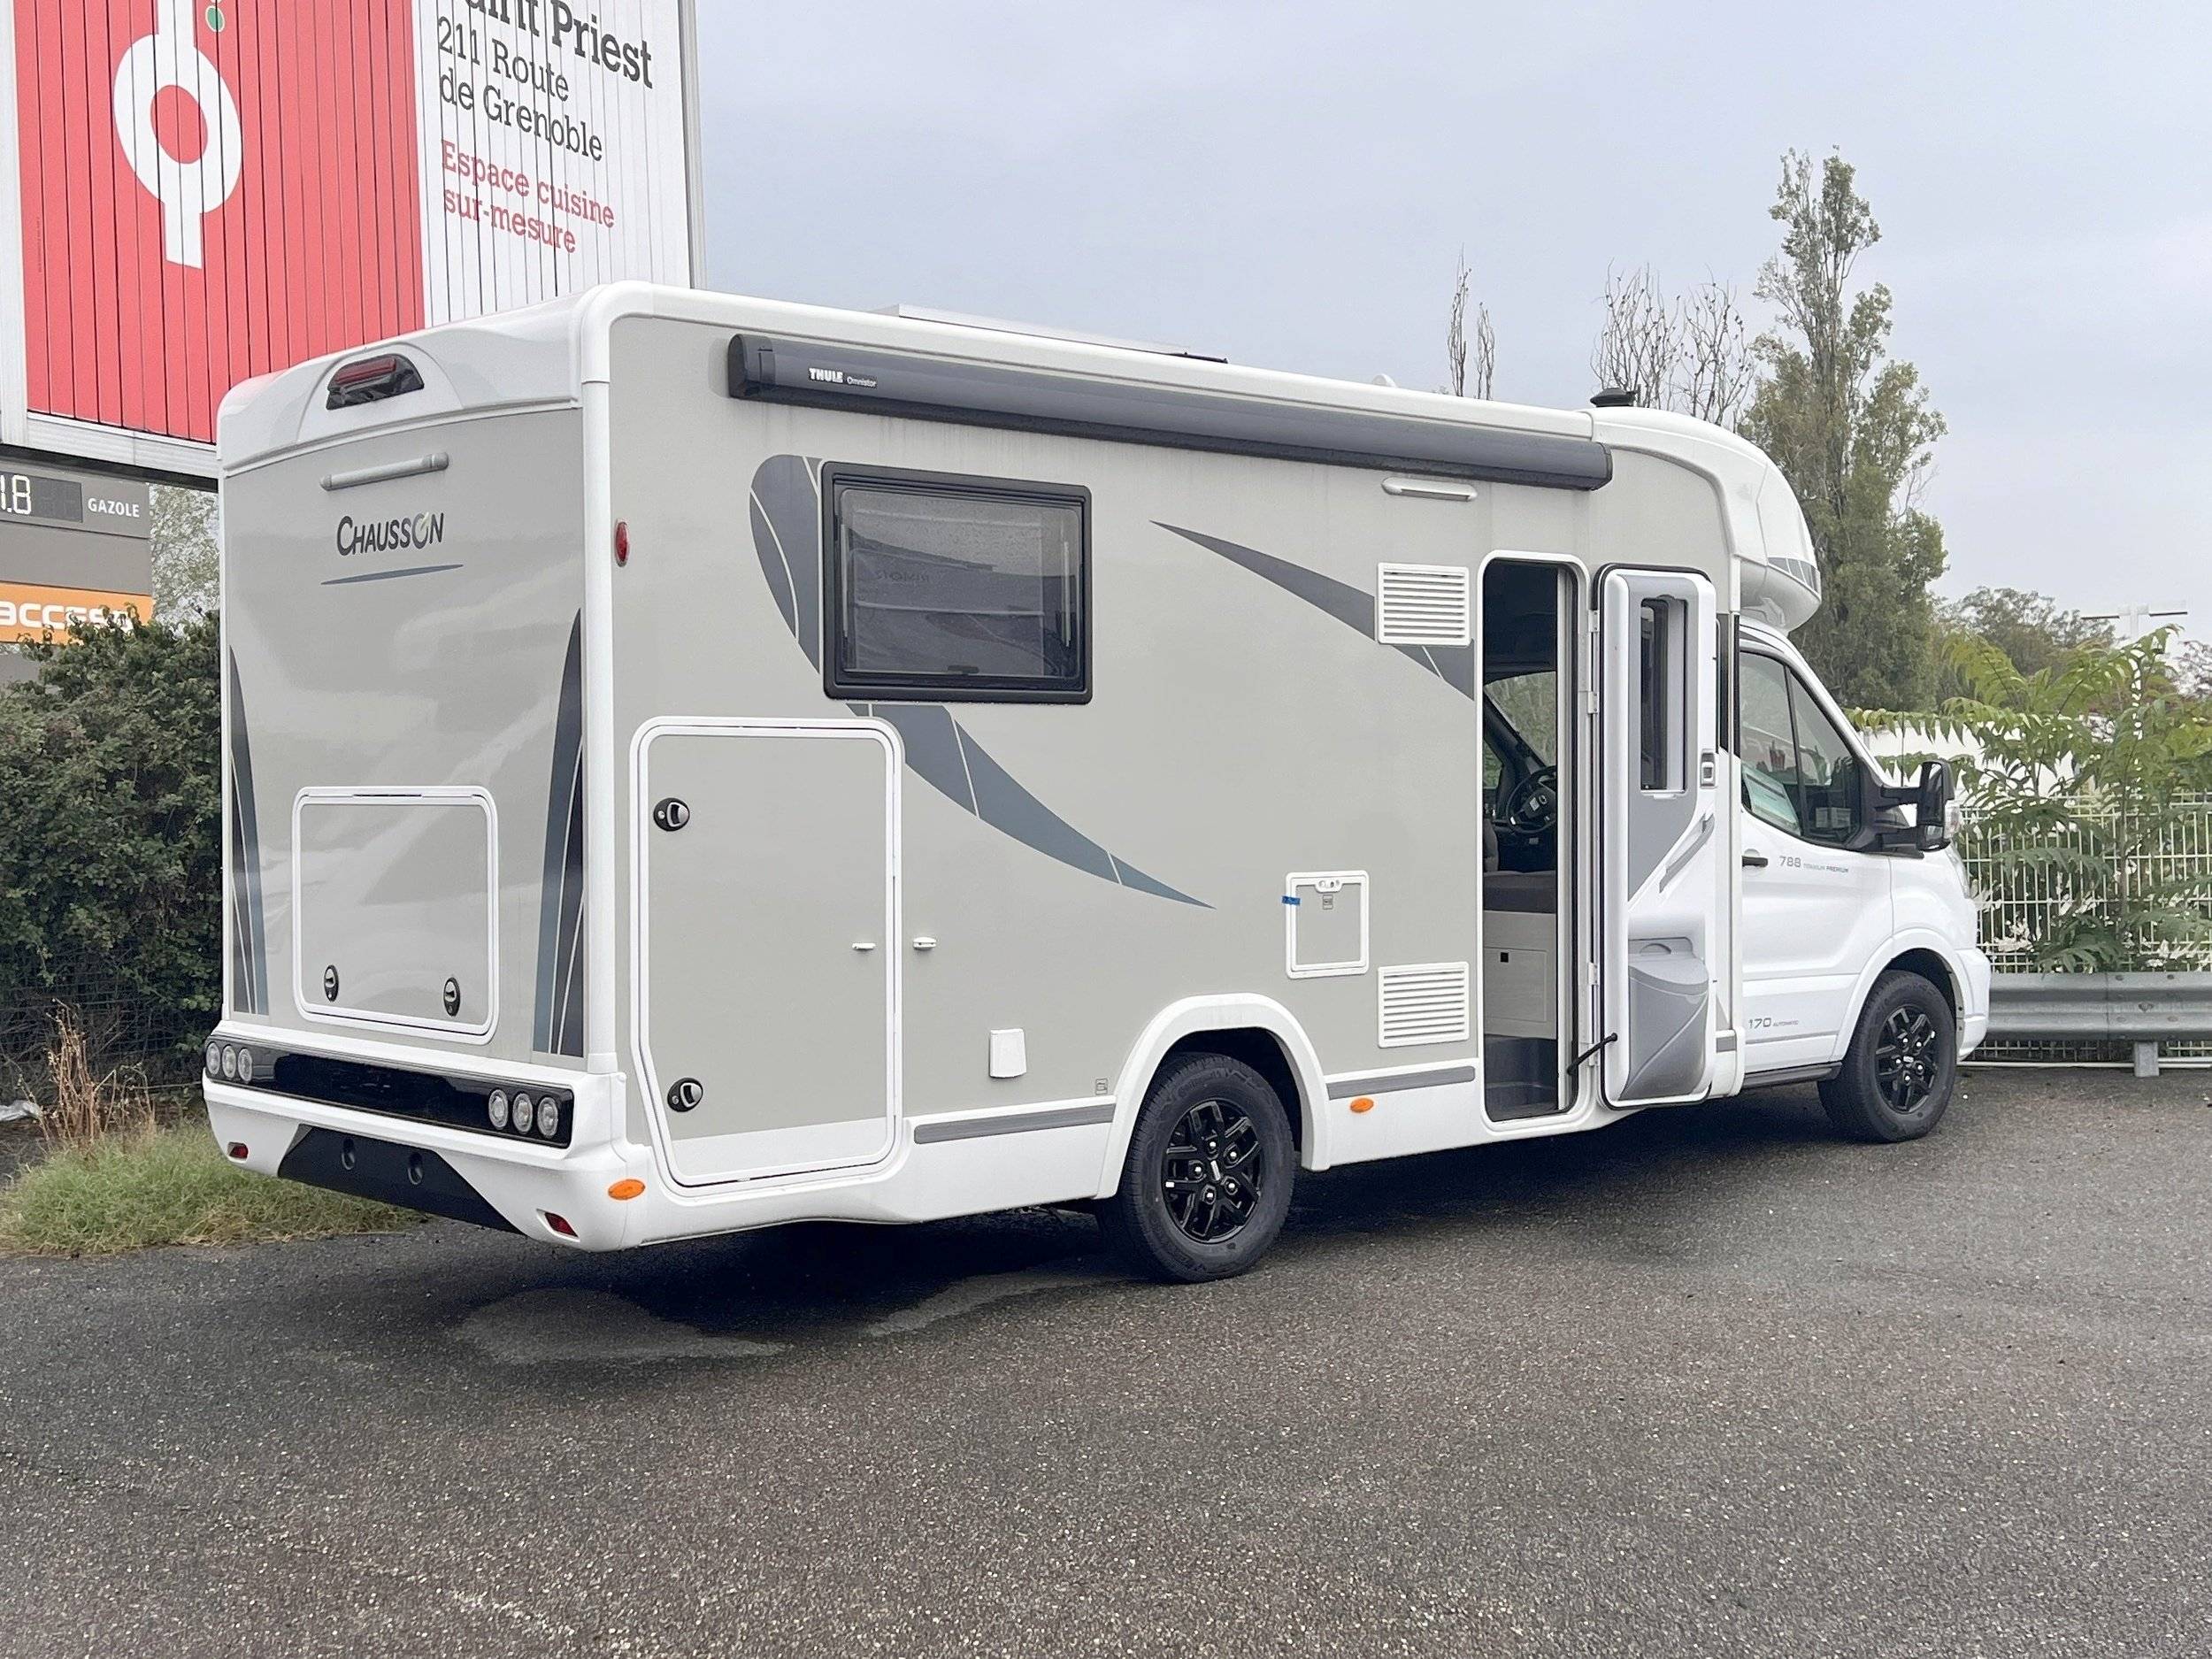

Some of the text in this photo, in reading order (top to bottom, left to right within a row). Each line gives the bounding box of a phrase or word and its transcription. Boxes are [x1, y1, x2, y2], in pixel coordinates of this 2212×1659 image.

[438, 16, 569, 102] 211 Route
[551, 0, 653, 88] Priest
[441, 66, 603, 161] de Grenoble
[442, 139, 614, 227] Espace cuisine
[443, 188, 575, 253] sur-mesure
[809, 367, 843, 383] THULE
[88, 497, 140, 518] GAZOLE
[1778, 855, 1801, 868] 788
[1748, 1018, 1771, 1029] 170
